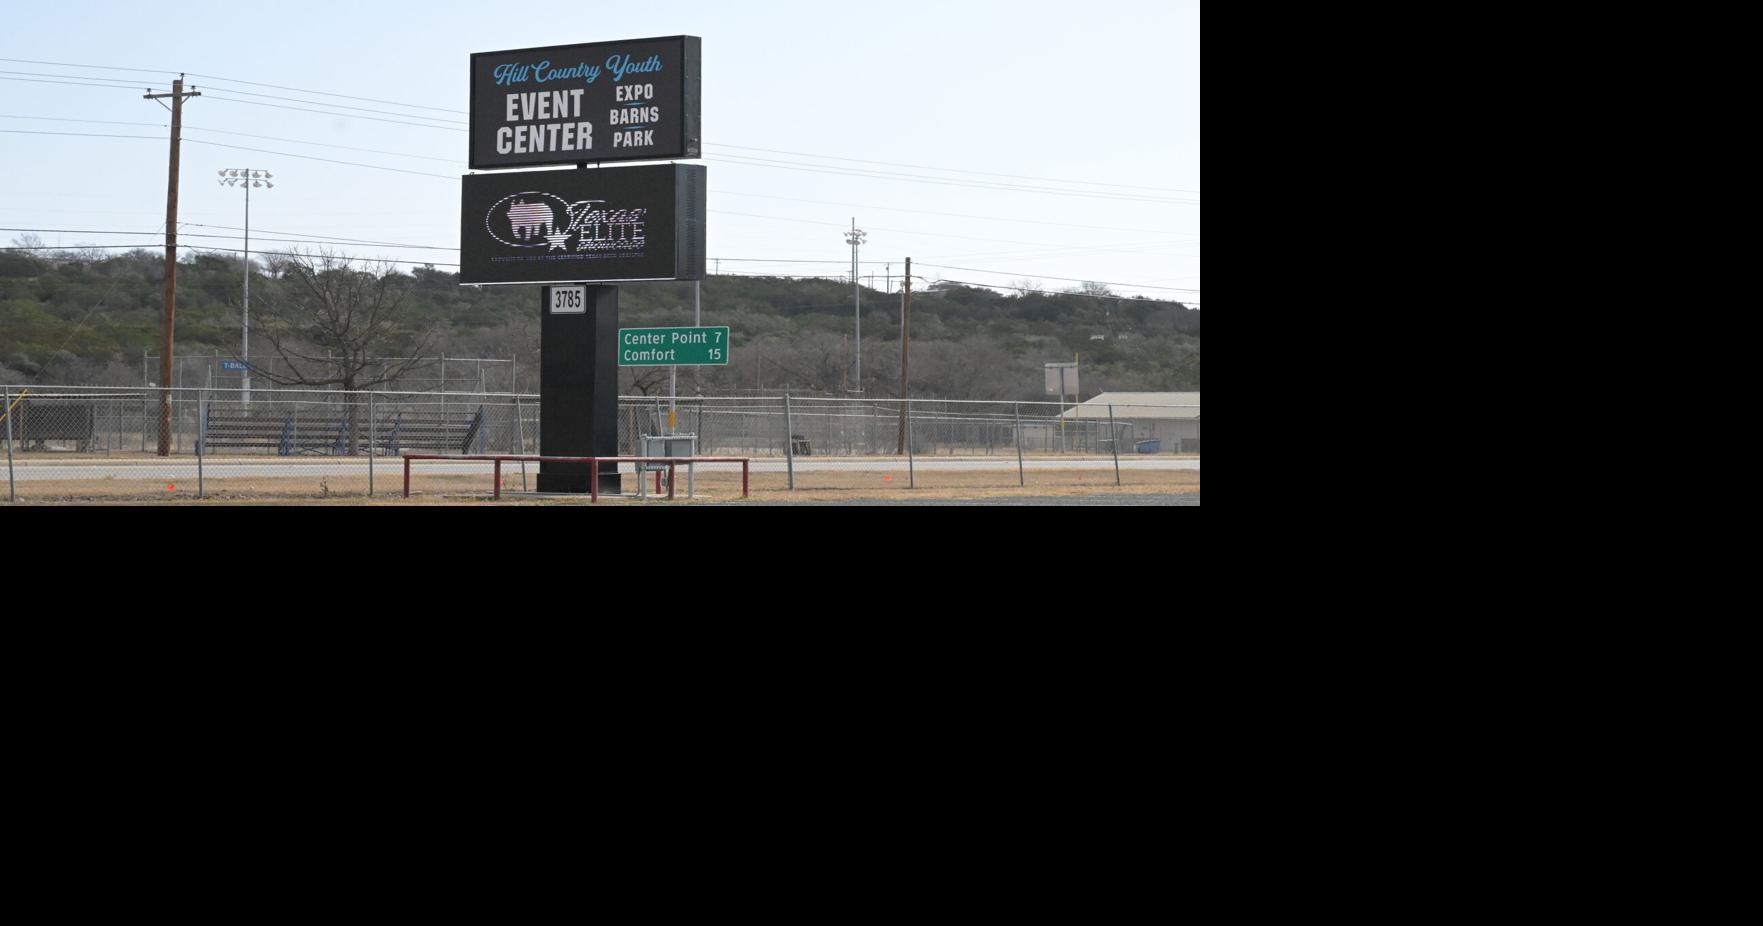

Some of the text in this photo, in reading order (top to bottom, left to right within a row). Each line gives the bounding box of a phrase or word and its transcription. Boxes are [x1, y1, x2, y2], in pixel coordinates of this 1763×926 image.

[493, 54, 663, 86] Hill Country Youth
[616, 83, 653, 101] EXPO
[506, 89, 584, 121] EVENT
[610, 106, 659, 125] BARNS
[496, 122, 593, 154] CENTER
[613, 130, 654, 147] PARK
[578, 221, 645, 242] ELITE
[555, 290, 581, 309] 3785
[624, 331, 722, 345] Center Point 7
[624, 348, 721, 361] Comfort 15
